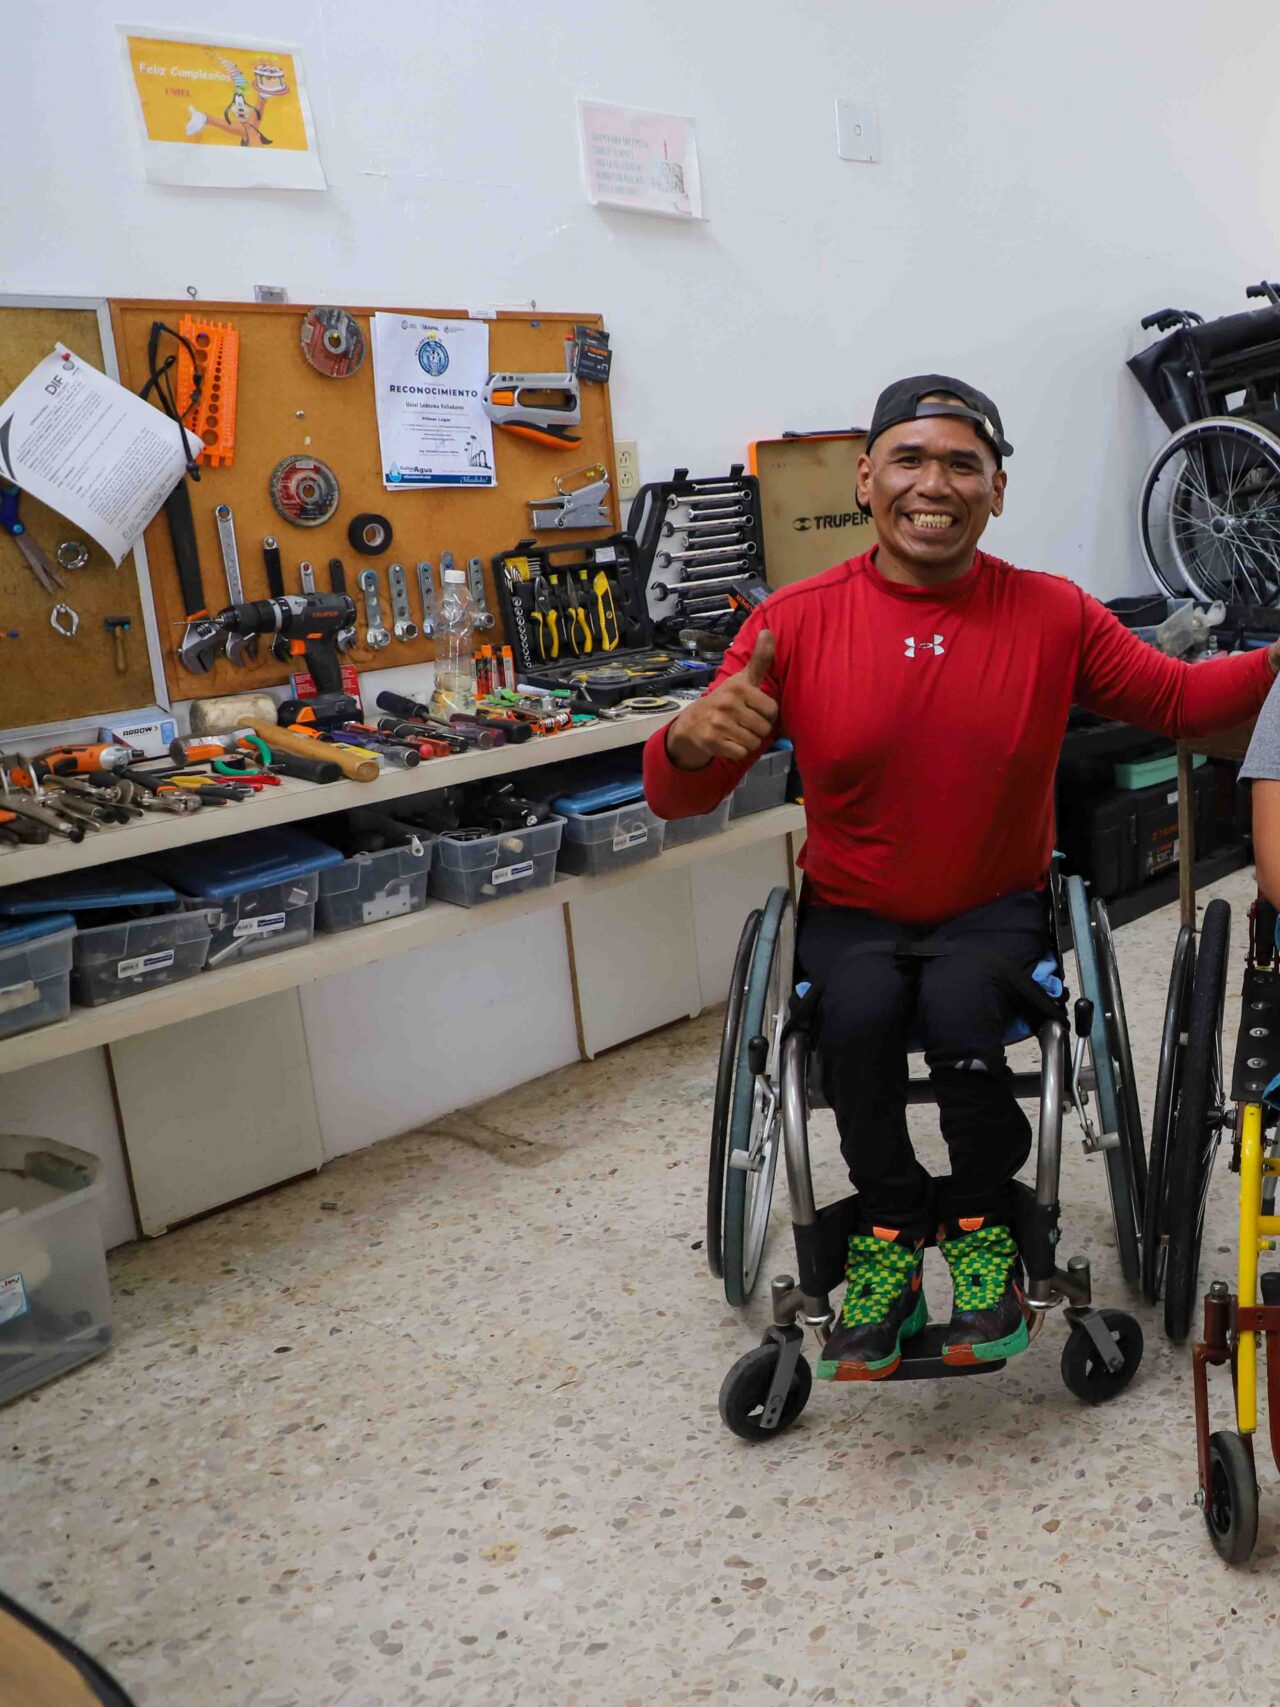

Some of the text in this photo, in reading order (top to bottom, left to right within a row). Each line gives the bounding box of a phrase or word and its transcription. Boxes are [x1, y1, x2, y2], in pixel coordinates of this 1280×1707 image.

[139, 62, 230, 82] Feliz Cumpleaños
[45, 374, 63, 395] DIF
[389, 384, 478, 398] RECONOCIMIENTO
[814, 512, 869, 530] TRUPER
[123, 726, 153, 737] ARROW
